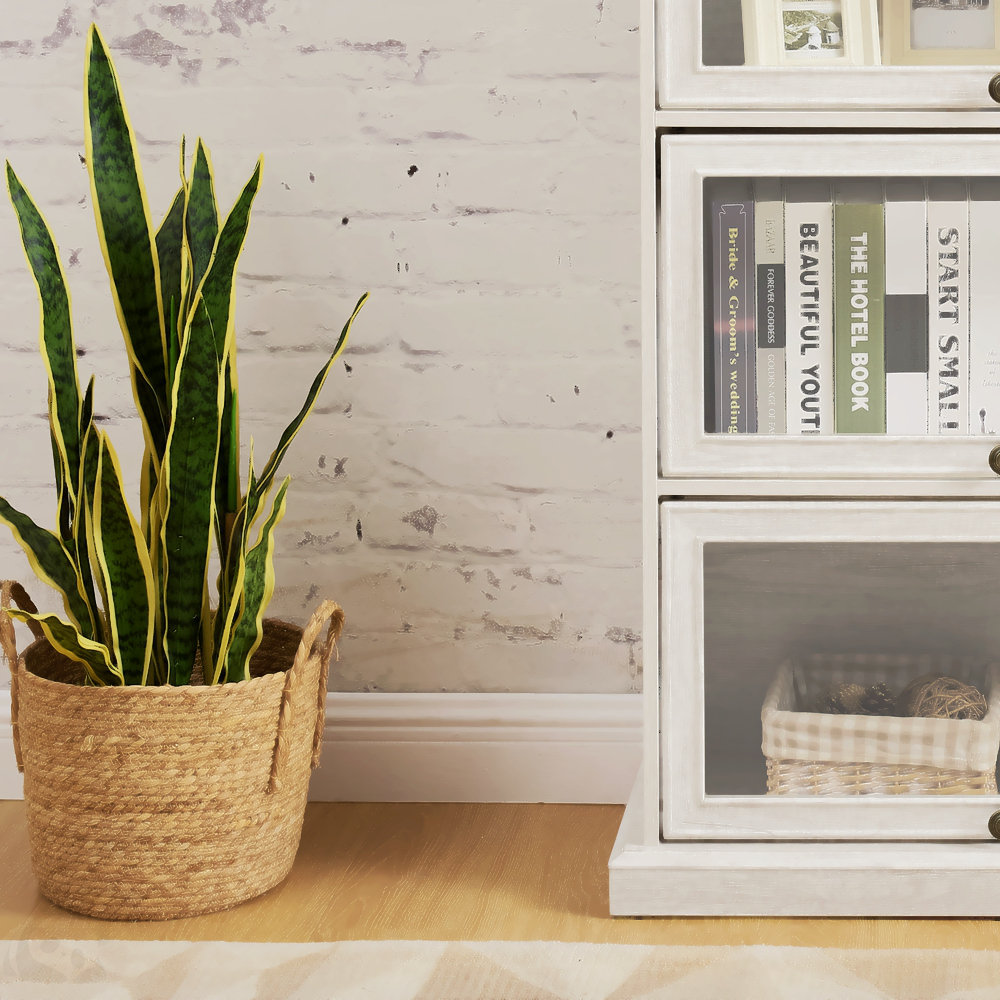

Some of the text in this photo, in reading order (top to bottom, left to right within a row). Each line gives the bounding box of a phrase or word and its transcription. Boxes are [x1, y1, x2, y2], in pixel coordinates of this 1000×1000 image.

[727, 227, 740, 434] Bride & Groom's wedding
[767, 306, 775, 344] GODDESS
[799, 223, 820, 356] BEAUTIFUL
[850, 232, 869, 412] THE HOTEL BOOK
[937, 227, 959, 324] START
